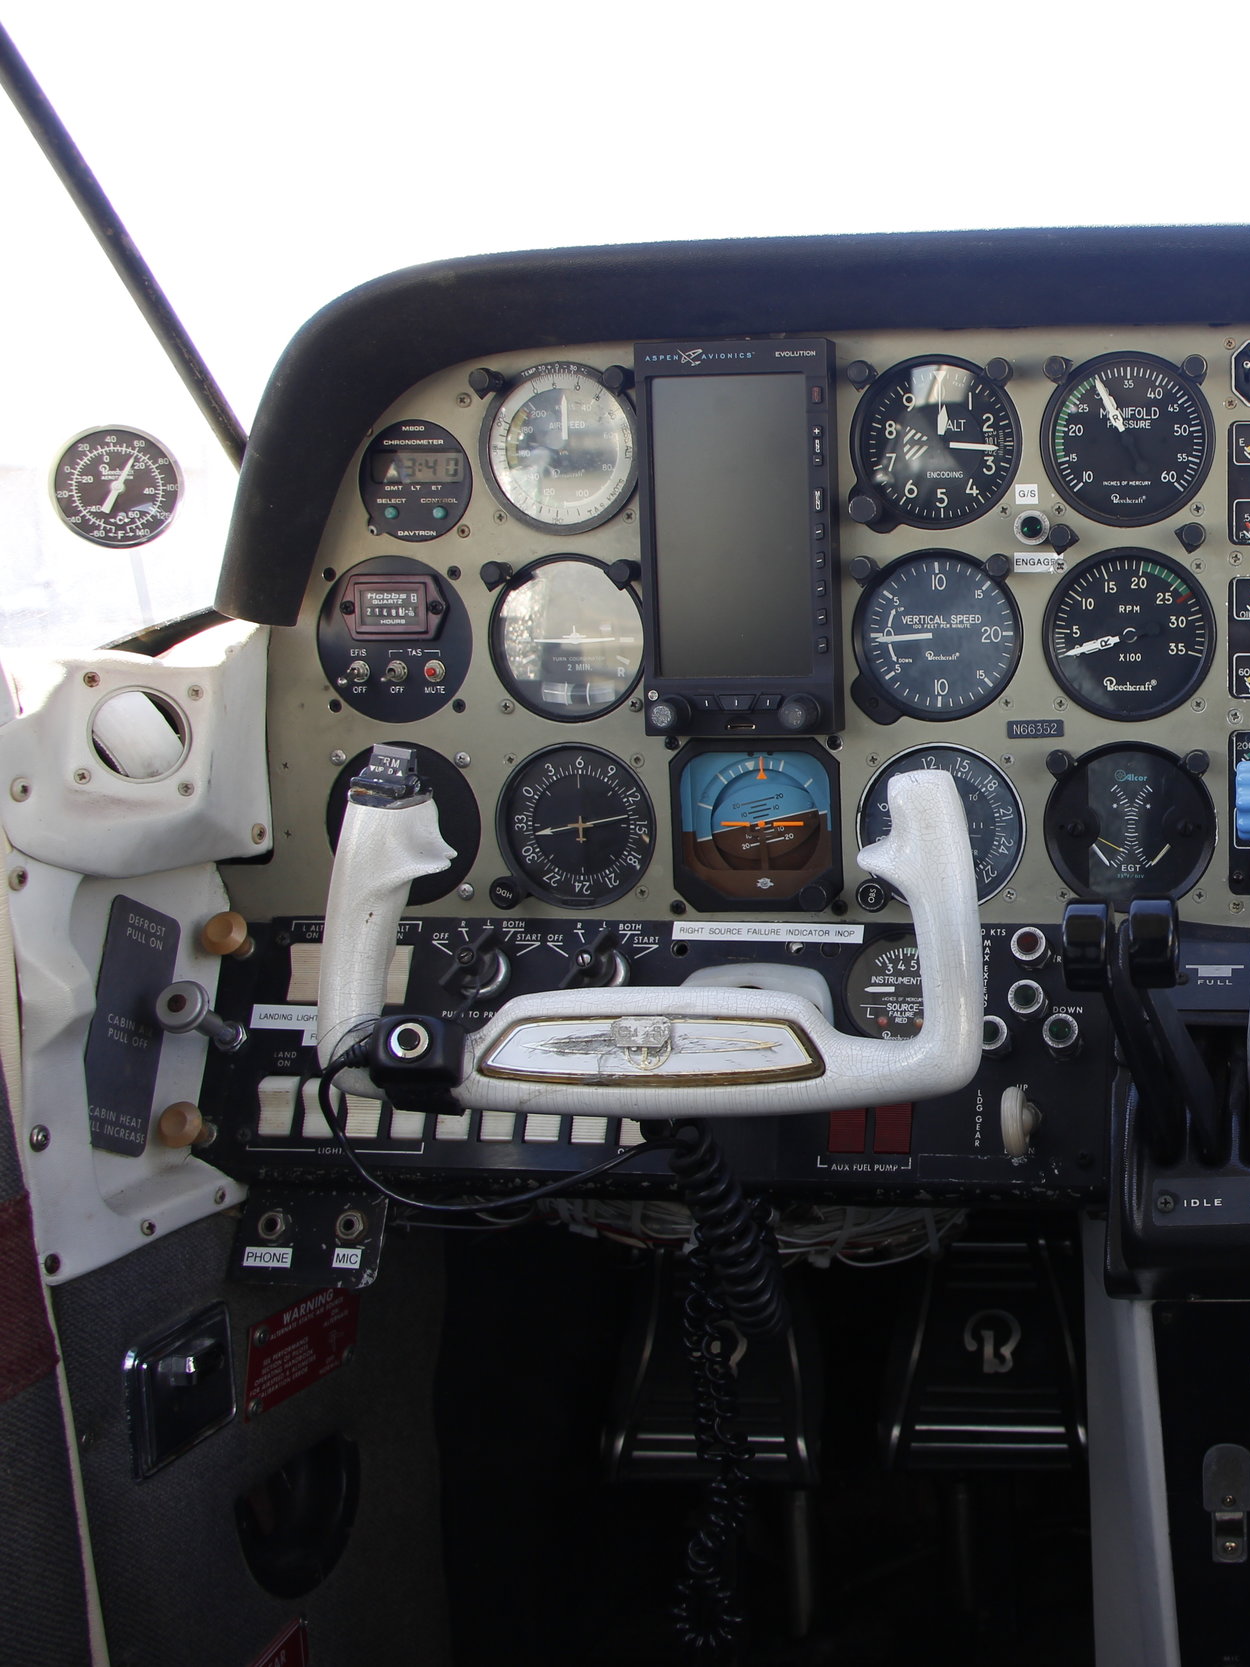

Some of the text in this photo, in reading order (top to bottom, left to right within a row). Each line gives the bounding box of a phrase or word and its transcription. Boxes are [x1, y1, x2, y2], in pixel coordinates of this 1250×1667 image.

[701, 352, 752, 360] AVIONICS
[946, 419, 965, 431] ALT
[927, 471, 963, 479] ENCODING
[1083, 471, 1093, 482] 10
[905, 481, 918, 498] 6
[1018, 490, 1036, 499] G/S
[1119, 605, 1140, 613] RPM
[901, 614, 981, 624] VERTICAL SPEED
[1169, 616, 1186, 628] 30
[1119, 653, 1142, 662] X100
[1103, 676, 1153, 692] Beechcraft
[424, 686, 445, 694] MUTE
[1013, 723, 1058, 735] N66352
[1121, 864, 1140, 872] EGT
[128, 914, 166, 937] DEFROST
[679, 927, 705, 936] RIGHT
[708, 928, 743, 936] SOURCE
[747, 928, 781, 936] FAILURE
[785, 929, 830, 937] INDICATOR
[871, 976, 921, 984] INSTRUMENT
[887, 1003, 919, 1011] SOURCE
[118, 1113, 142, 1129] HEAT
[831, 1163, 850, 1171] AUX
[873, 1164, 898, 1172] PUMP
[1183, 1198, 1223, 1207] IDLE
[246, 1250, 289, 1264] PHONE
[335, 1252, 359, 1264] MIC
[283, 1289, 334, 1325] WARNING
